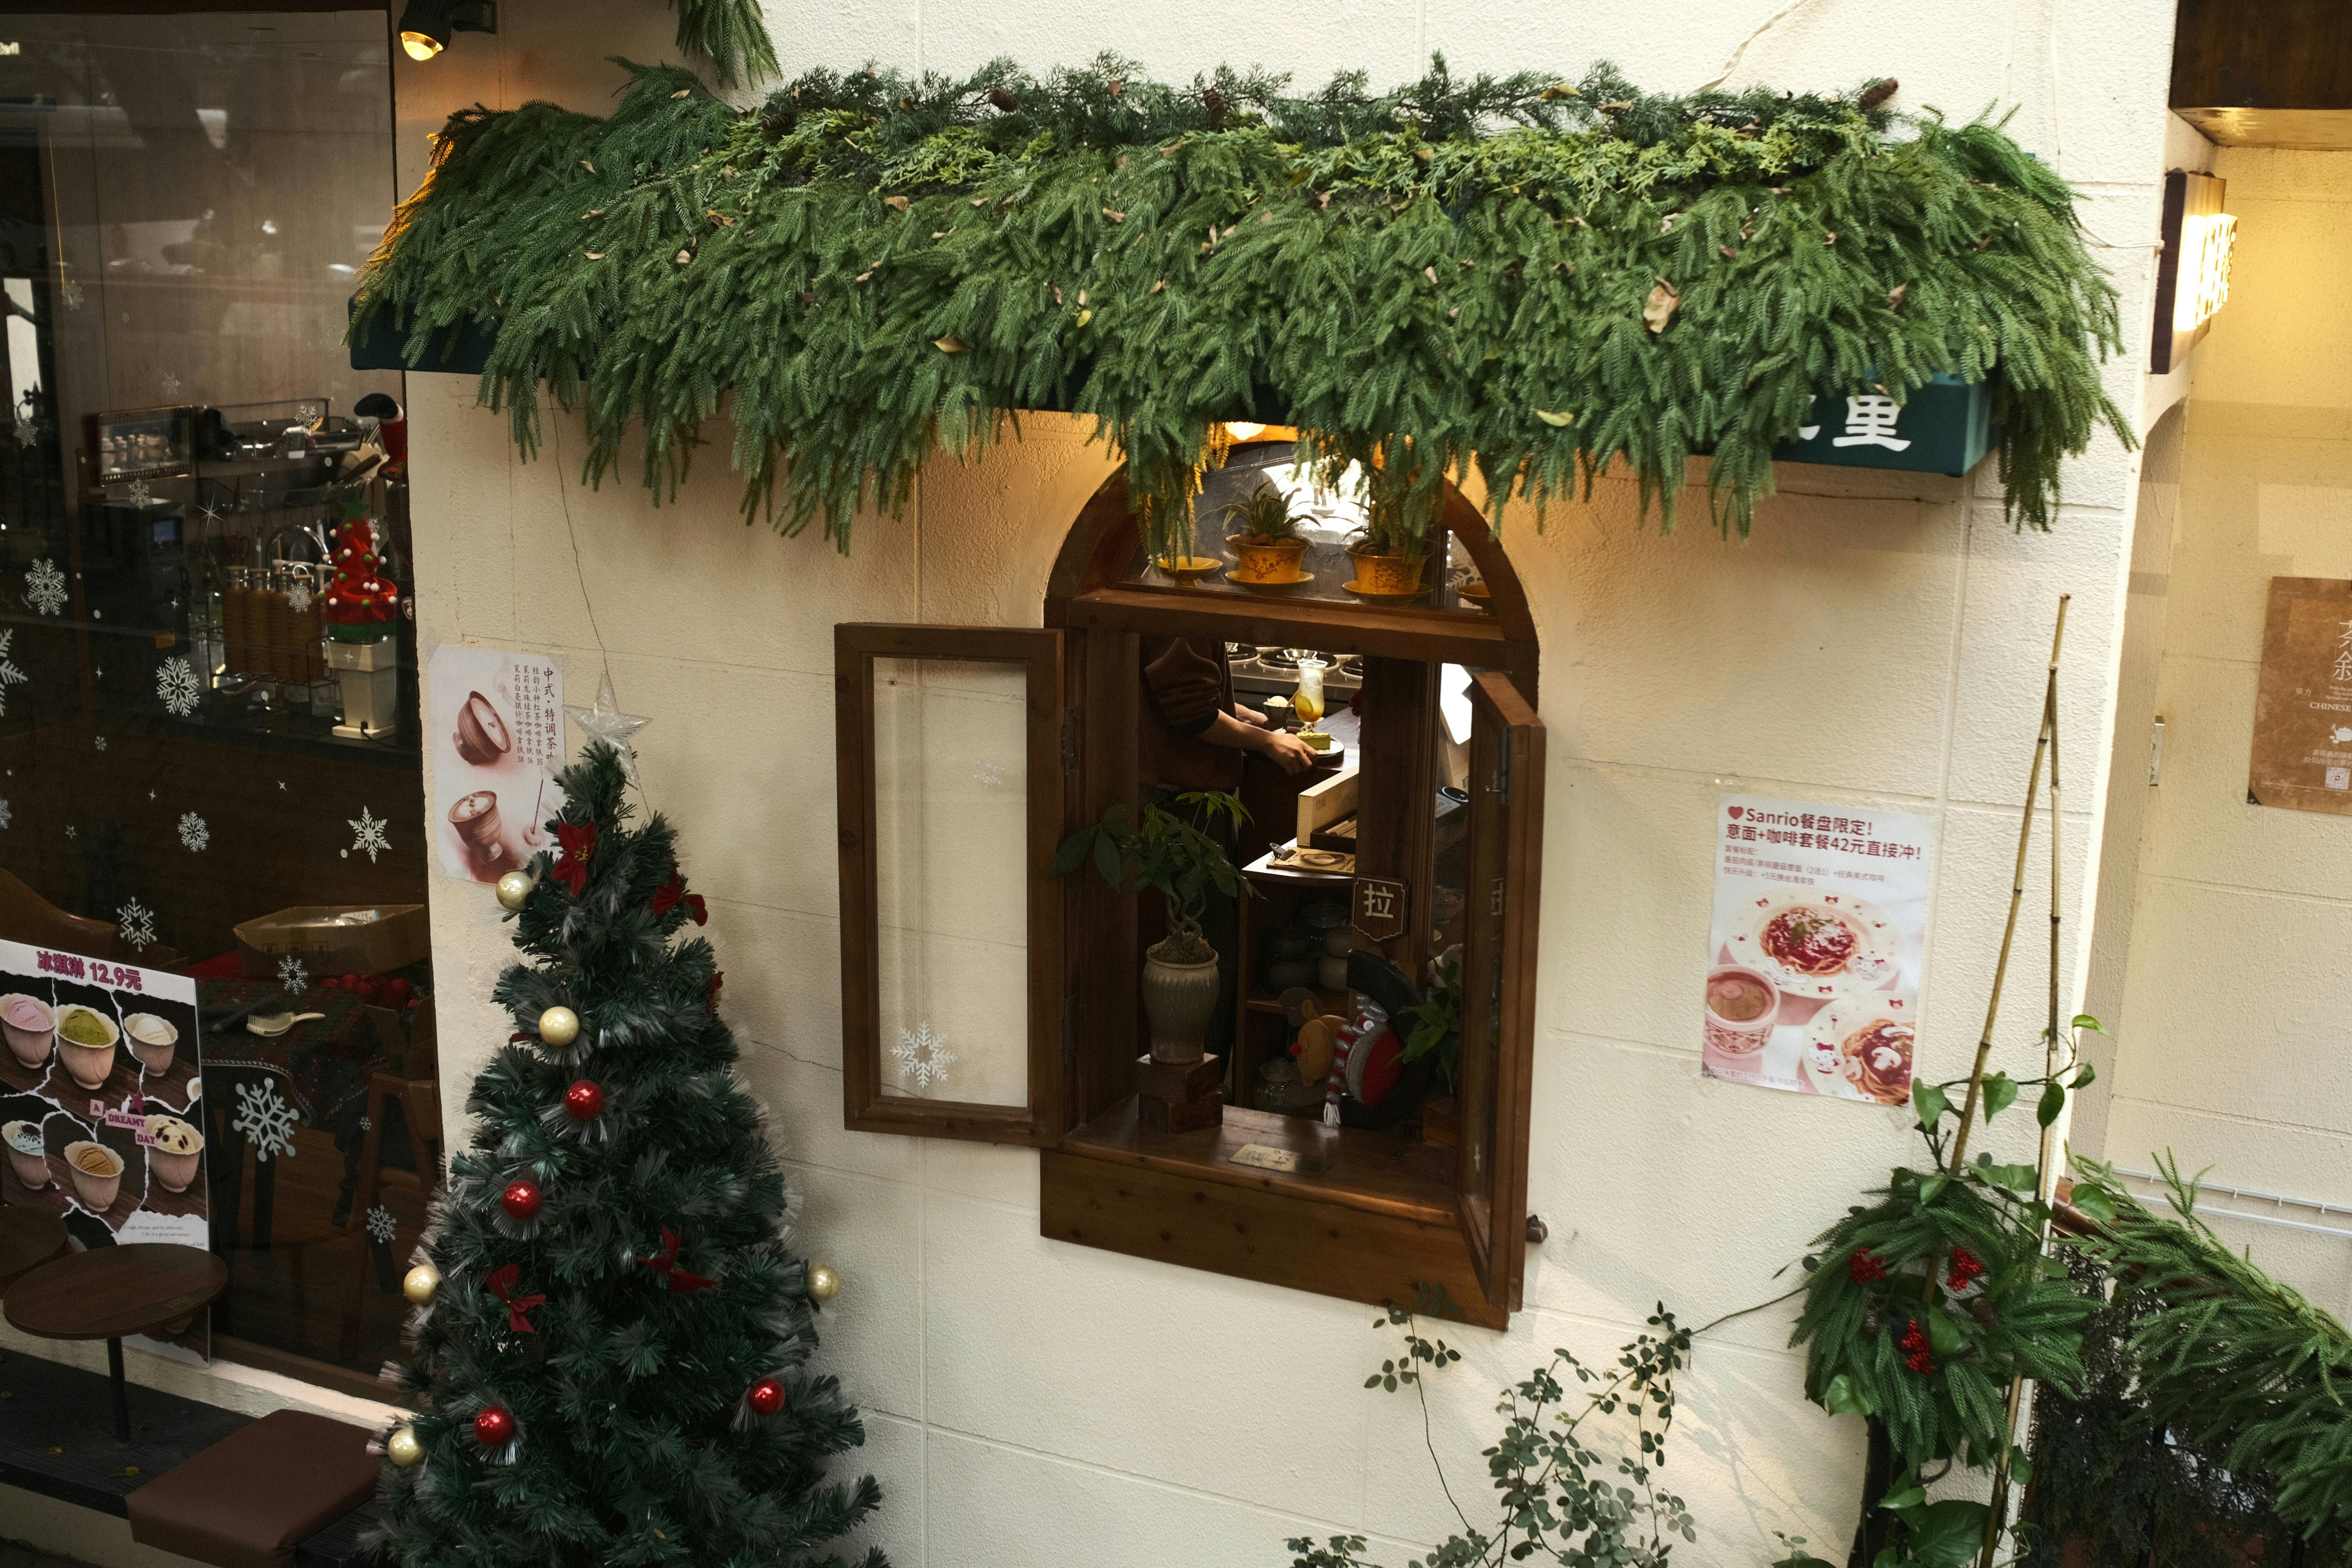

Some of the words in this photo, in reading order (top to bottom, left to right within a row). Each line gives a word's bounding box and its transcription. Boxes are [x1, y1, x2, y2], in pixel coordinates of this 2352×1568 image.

[514, 664, 525, 754] 茉莉白毫银针咖啡拿铁
[523, 665, 534, 755] 茉莉龙珠绿茶咖啡拿铁
[2309, 702, 2352, 712] CHINESE
[1363, 883, 1394, 919] 拉
[37, 951, 85, 979] 冰淇淋
[89, 962, 142, 991] 12.9元
[93, 1104, 100, 1112] A
[108, 1114, 145, 1127] DREAMY
[137, 1134, 156, 1144] DAY
